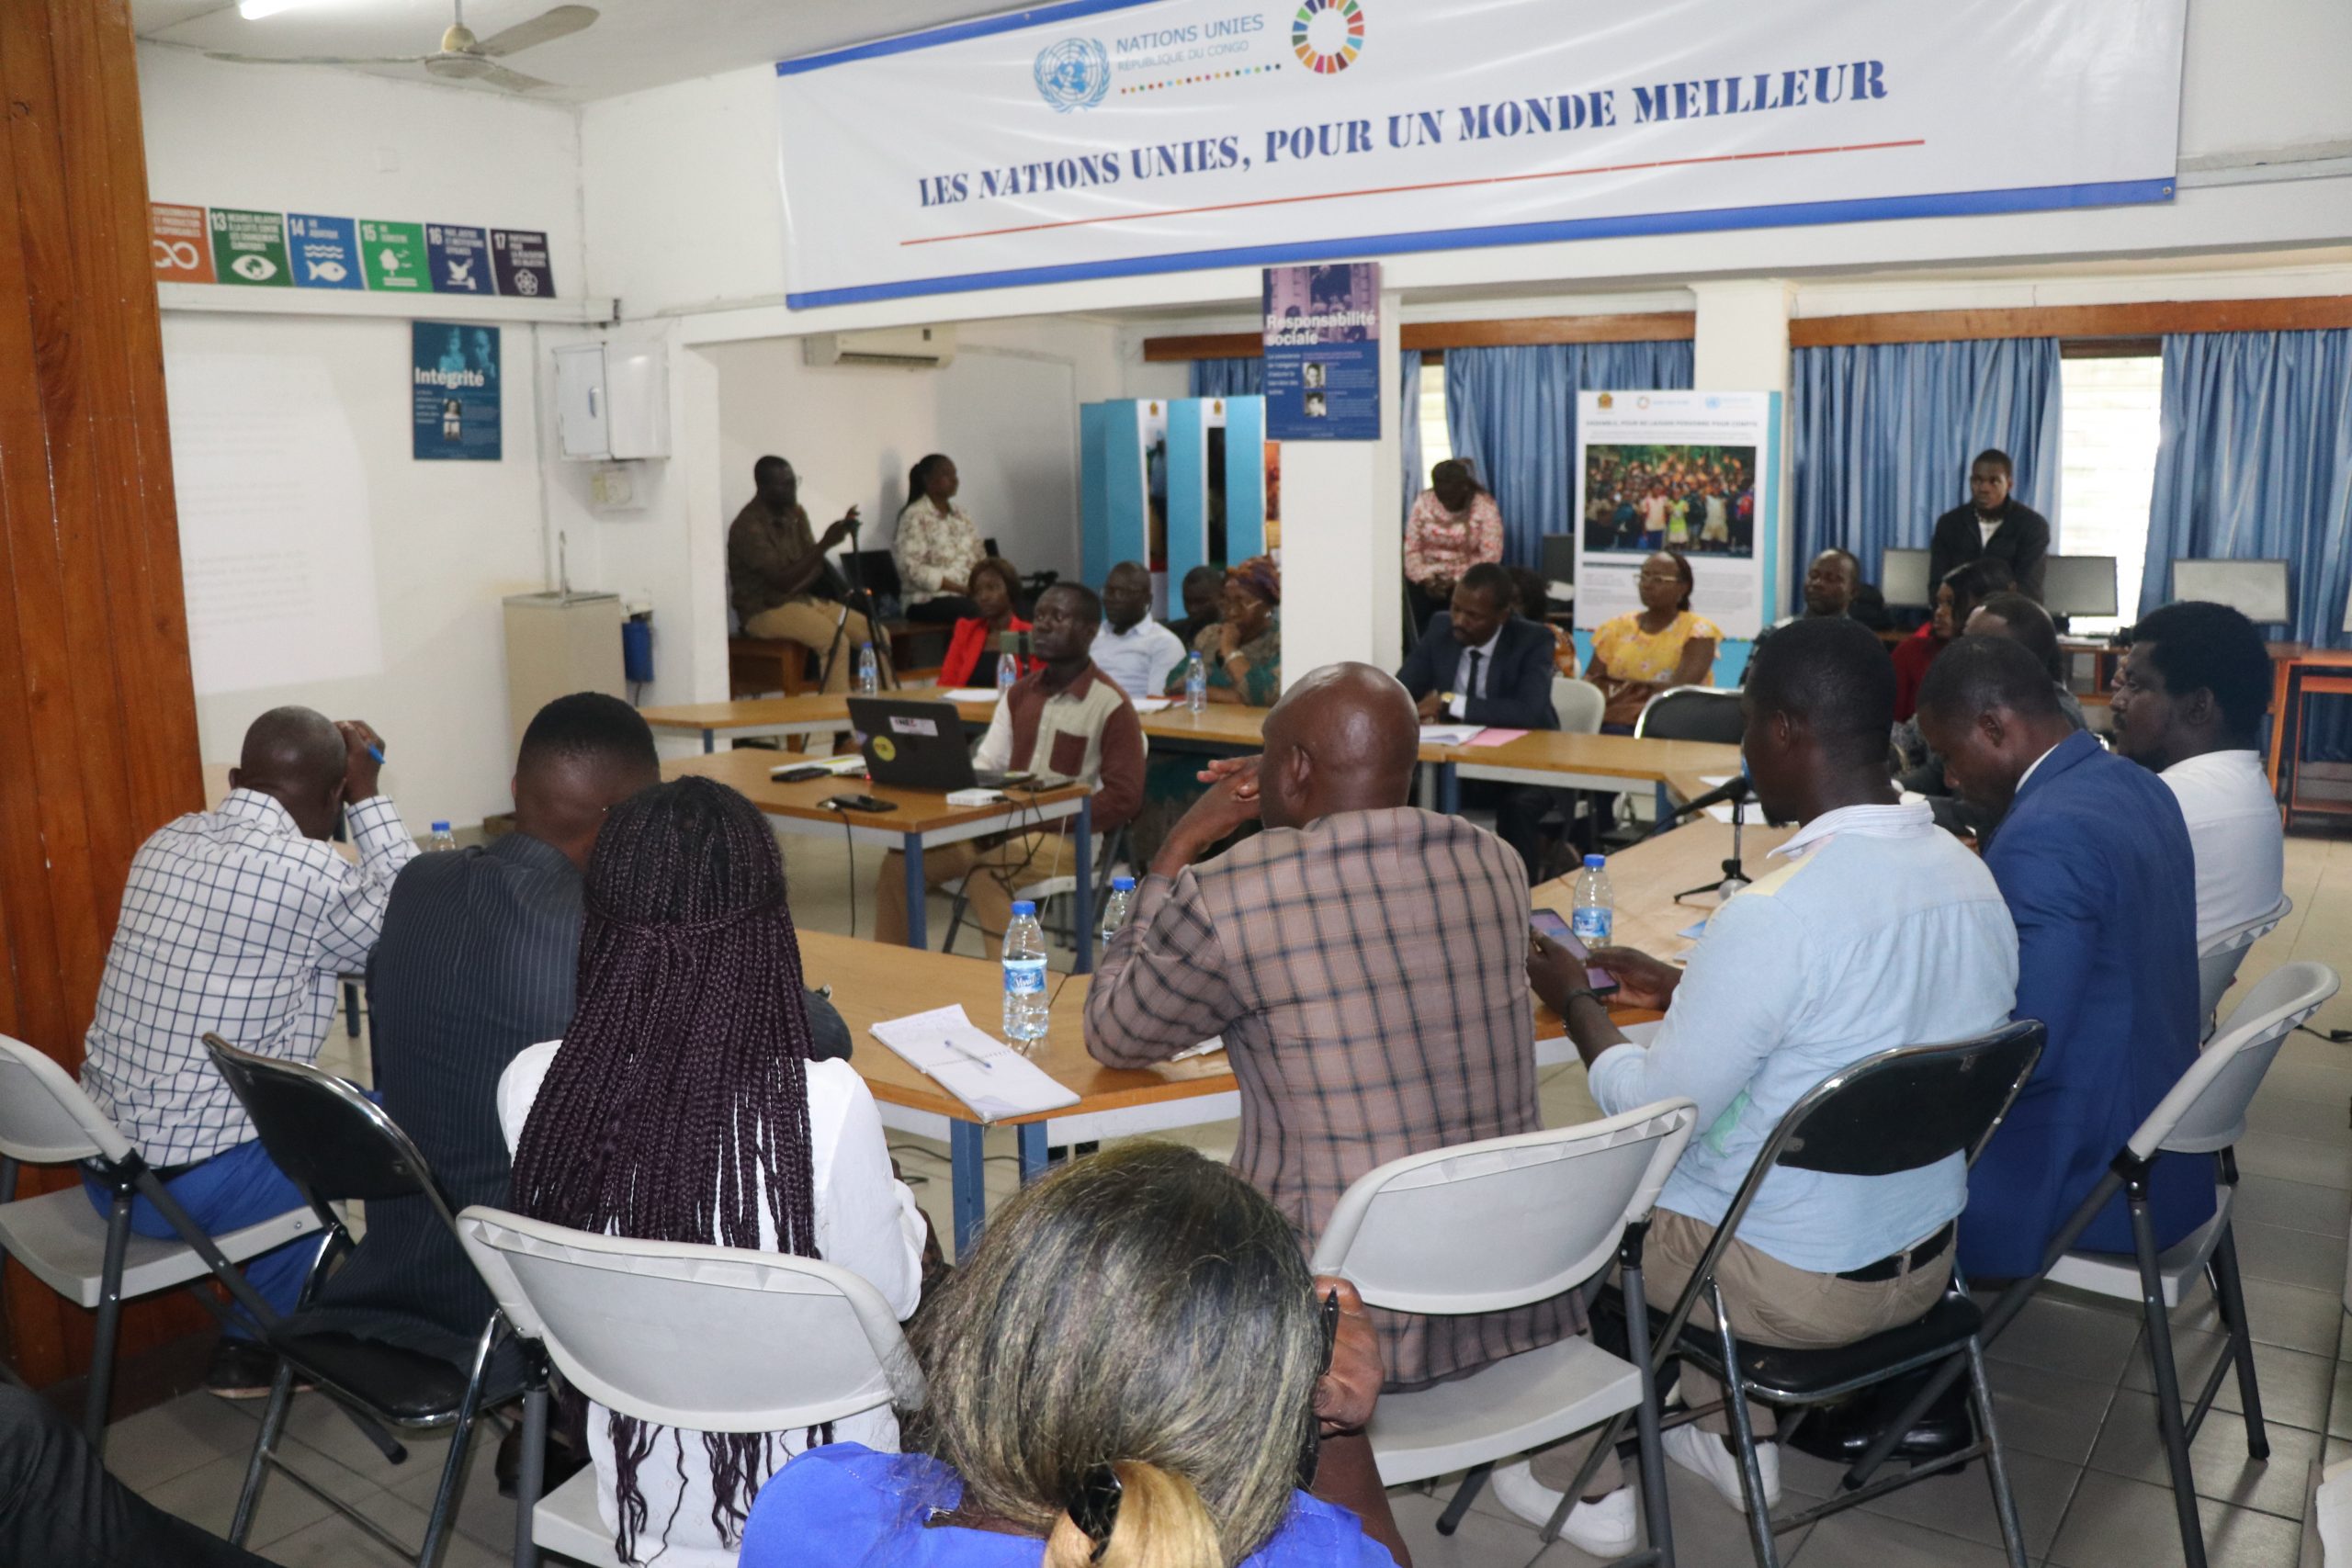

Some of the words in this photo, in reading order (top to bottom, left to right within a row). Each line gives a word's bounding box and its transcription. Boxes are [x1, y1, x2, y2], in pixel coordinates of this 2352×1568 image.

[1116, 26, 1198, 54] NATIONS
[1204, 14, 1265, 39] UNIES
[1117, 51, 1185, 72] RÉPUBLIQUE
[1188, 48, 1204, 61] DU
[1207, 39, 1250, 57] CONGO
[919, 173, 969, 208] LES
[978, 152, 1121, 199] NATIONS
[1131, 135, 1251, 180] UNIES,
[1264, 118, 1374, 164] POUR
[1387, 109, 1445, 149] UN
[1458, 90, 1617, 141] MONDE
[1631, 59, 1889, 125] MEILLEUR
[210, 211, 228, 232] 13
[289, 218, 306, 237] 14
[362, 223, 378, 243] 15
[428, 227, 443, 245] 16
[493, 232, 506, 251] 17
[1267, 310, 1376, 333] Responsabilité
[1267, 330, 1318, 346] sociale
[415, 367, 485, 389] Intégrité
